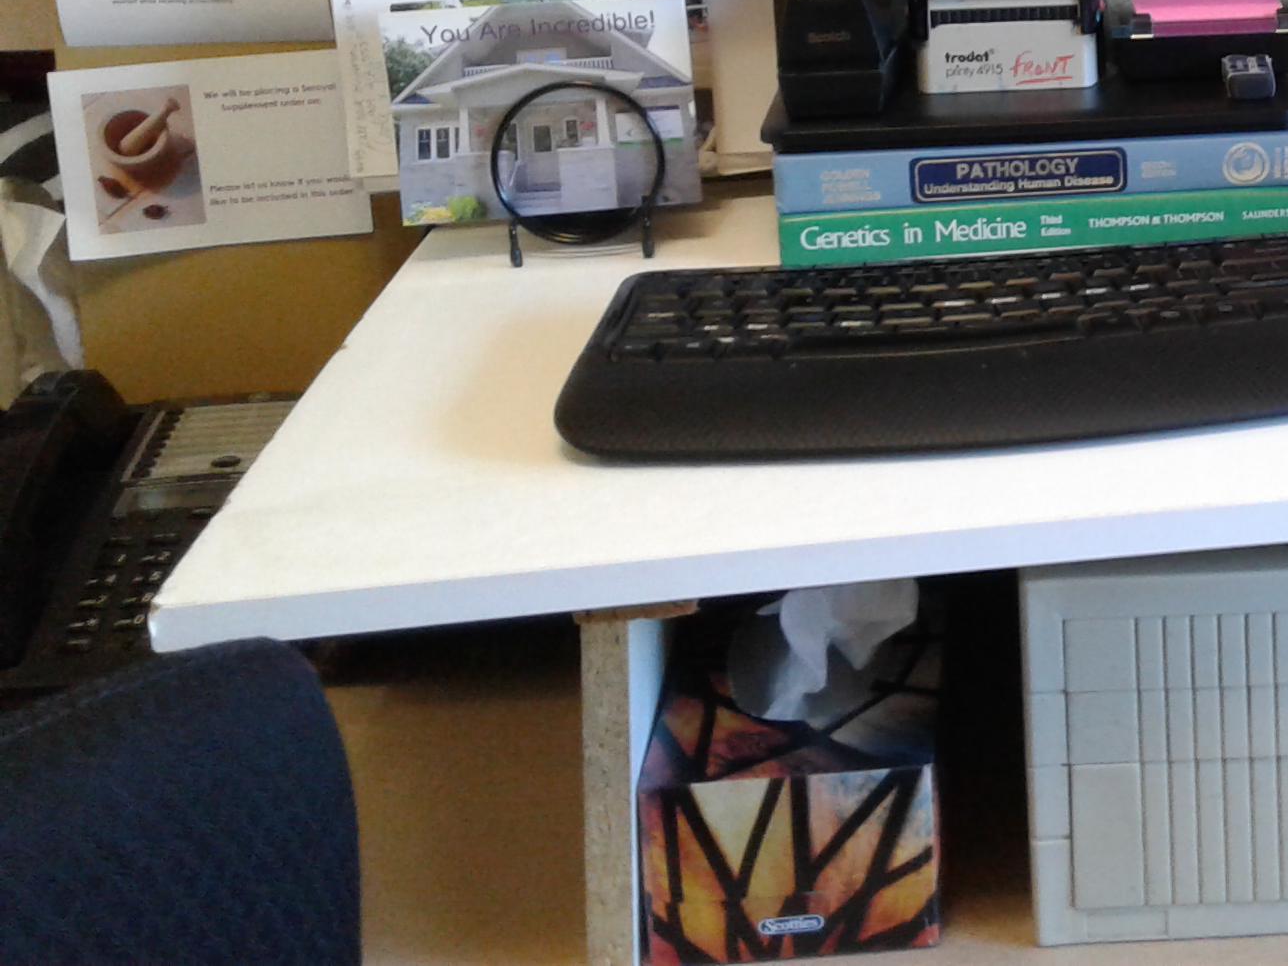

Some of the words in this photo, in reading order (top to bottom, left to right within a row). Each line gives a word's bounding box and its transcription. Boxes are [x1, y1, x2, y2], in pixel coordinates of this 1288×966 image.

[420, 24, 471, 45] You
[478, 21, 522, 42] Are
[529, 9, 656, 37] Incredible!
[955, 157, 1080, 180] PATHOLOGY
[923, 178, 1016, 195] Understanding
[1017, 175, 1062, 191] Human
[1064, 174, 1115, 188] Disease
[1040, 214, 1063, 225] Third
[1087, 215, 1150, 228] THOMPSON
[1151, 214, 1161, 225] &
[1162, 210, 1226, 225] THOMPSON
[799, 225, 892, 251] Genetics
[902, 221, 923, 245] in
[934, 216, 1028, 242] Medicine
[1040, 226, 1072, 237] Edition
